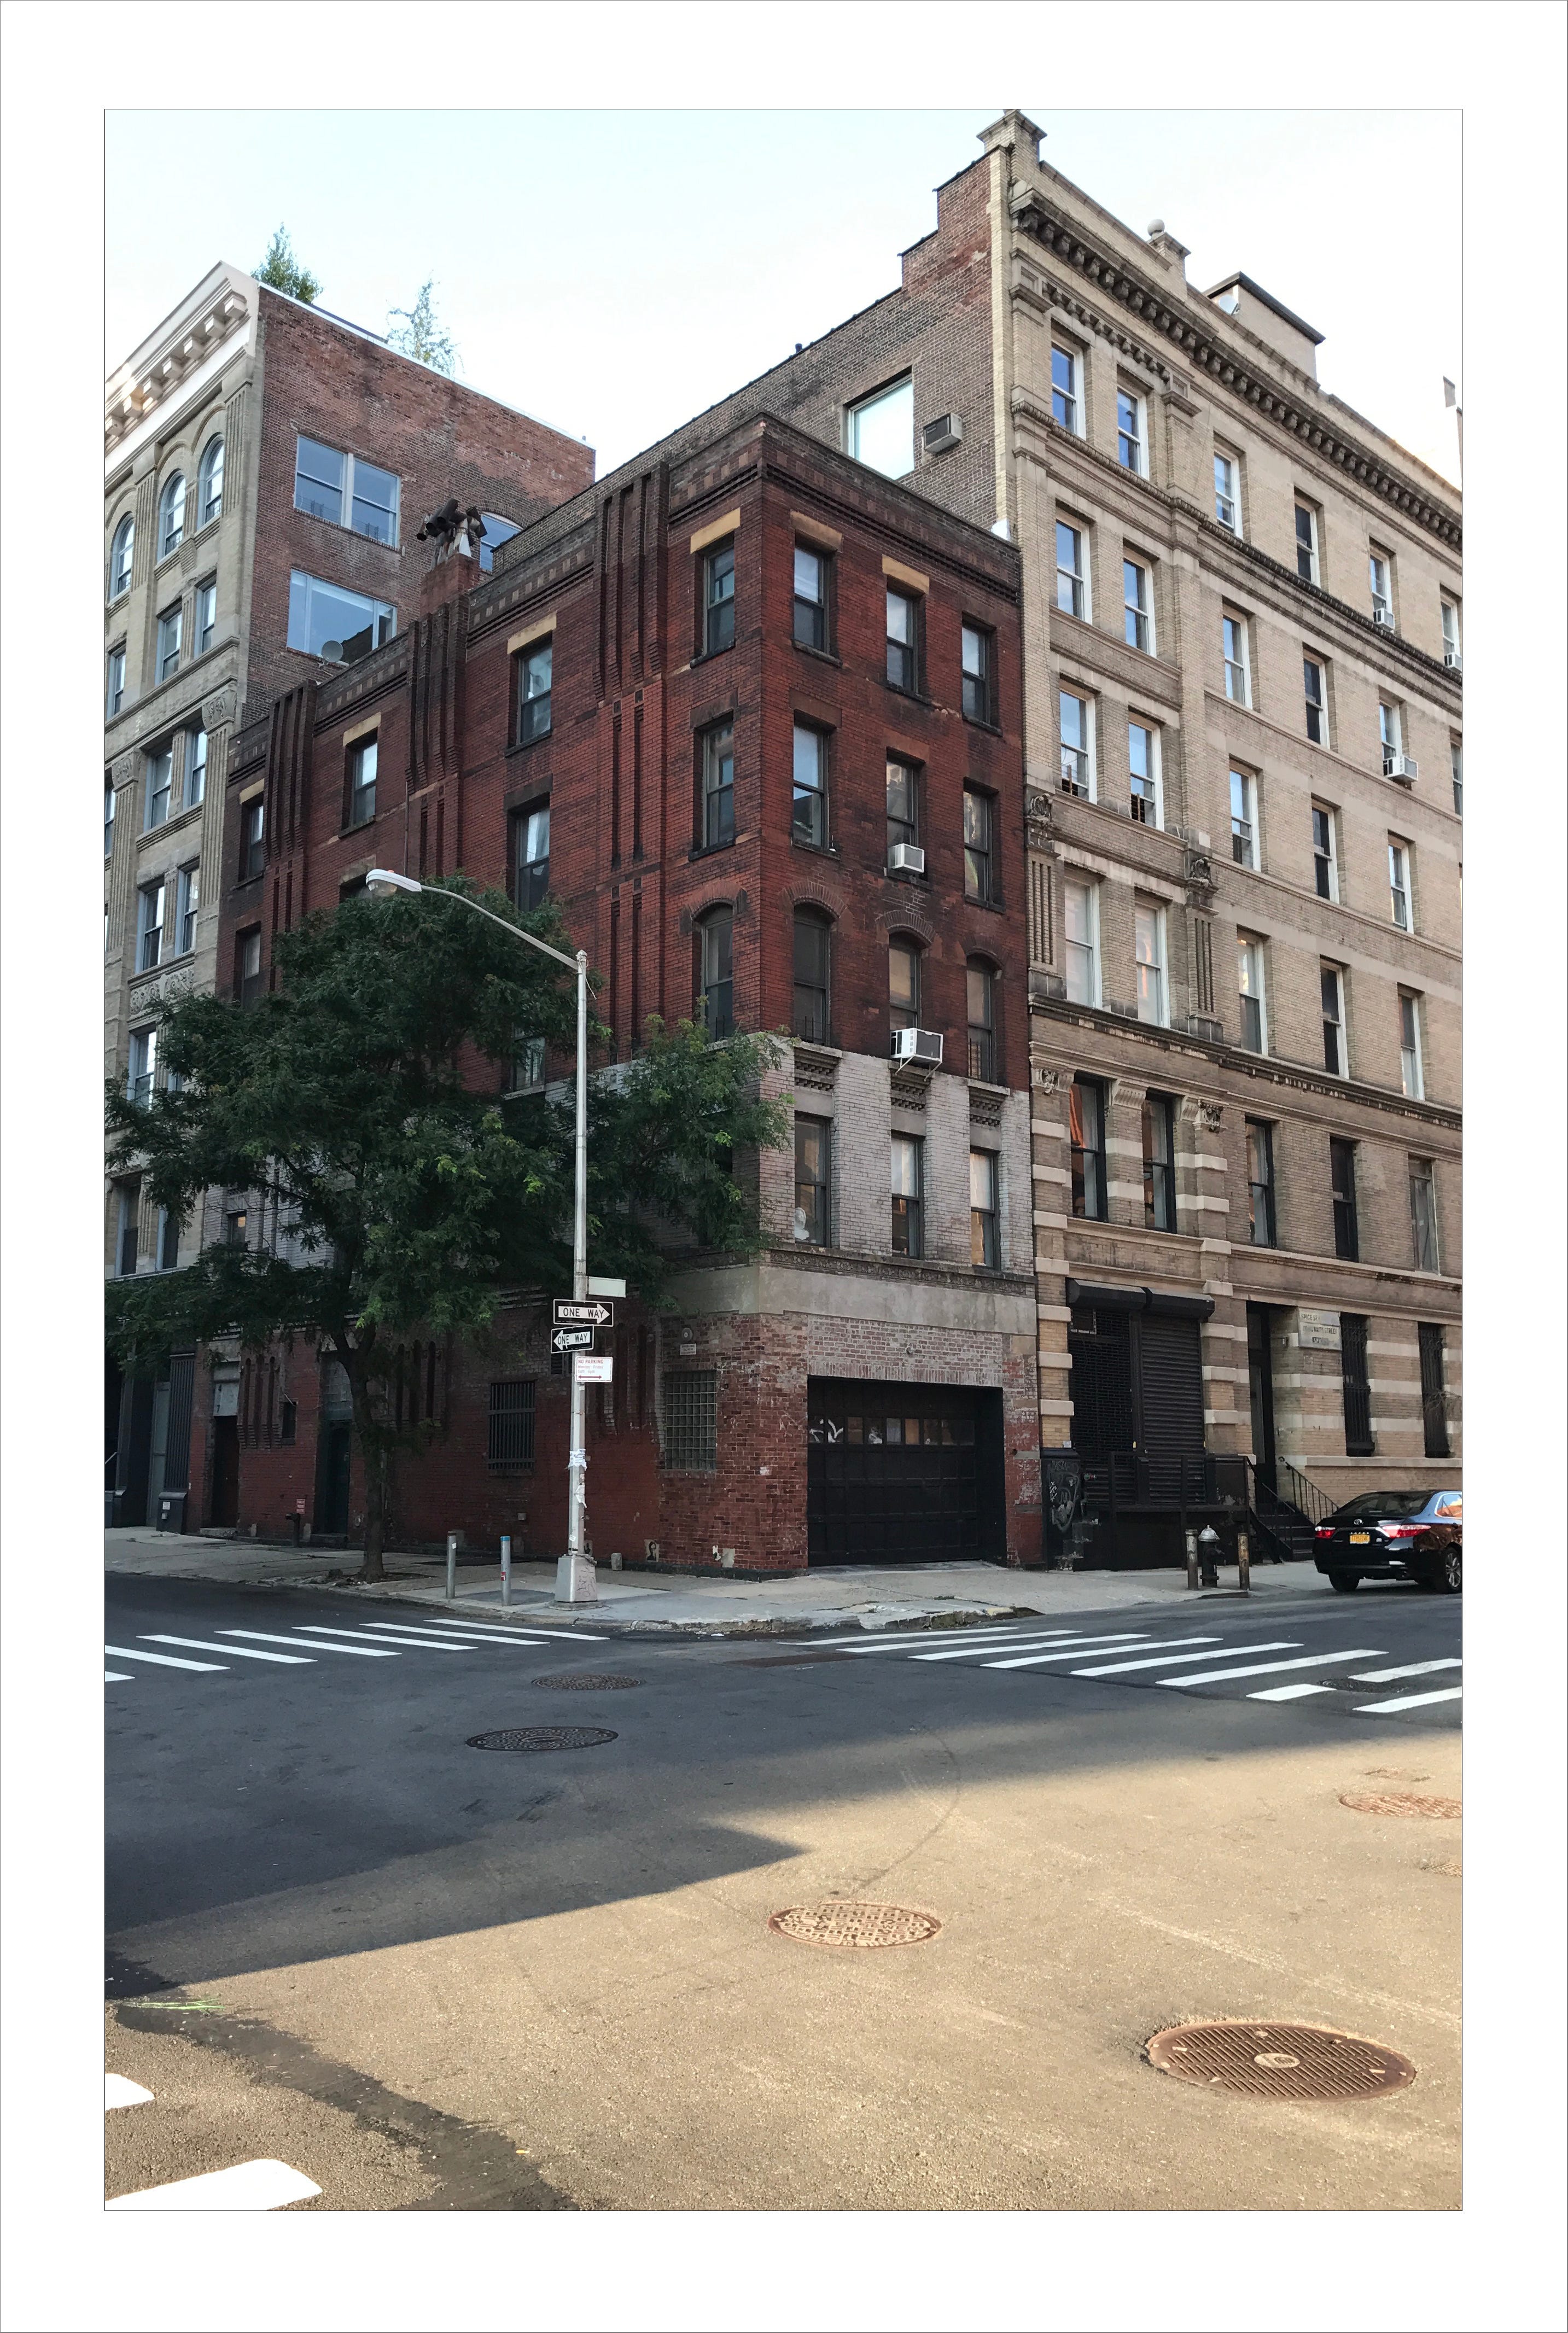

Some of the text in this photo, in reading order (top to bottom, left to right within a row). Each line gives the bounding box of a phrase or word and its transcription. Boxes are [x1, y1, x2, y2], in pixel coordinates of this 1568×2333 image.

[563, 1308, 604, 1319] ONE WAY
[557, 1333, 587, 1345] ONE WAY
